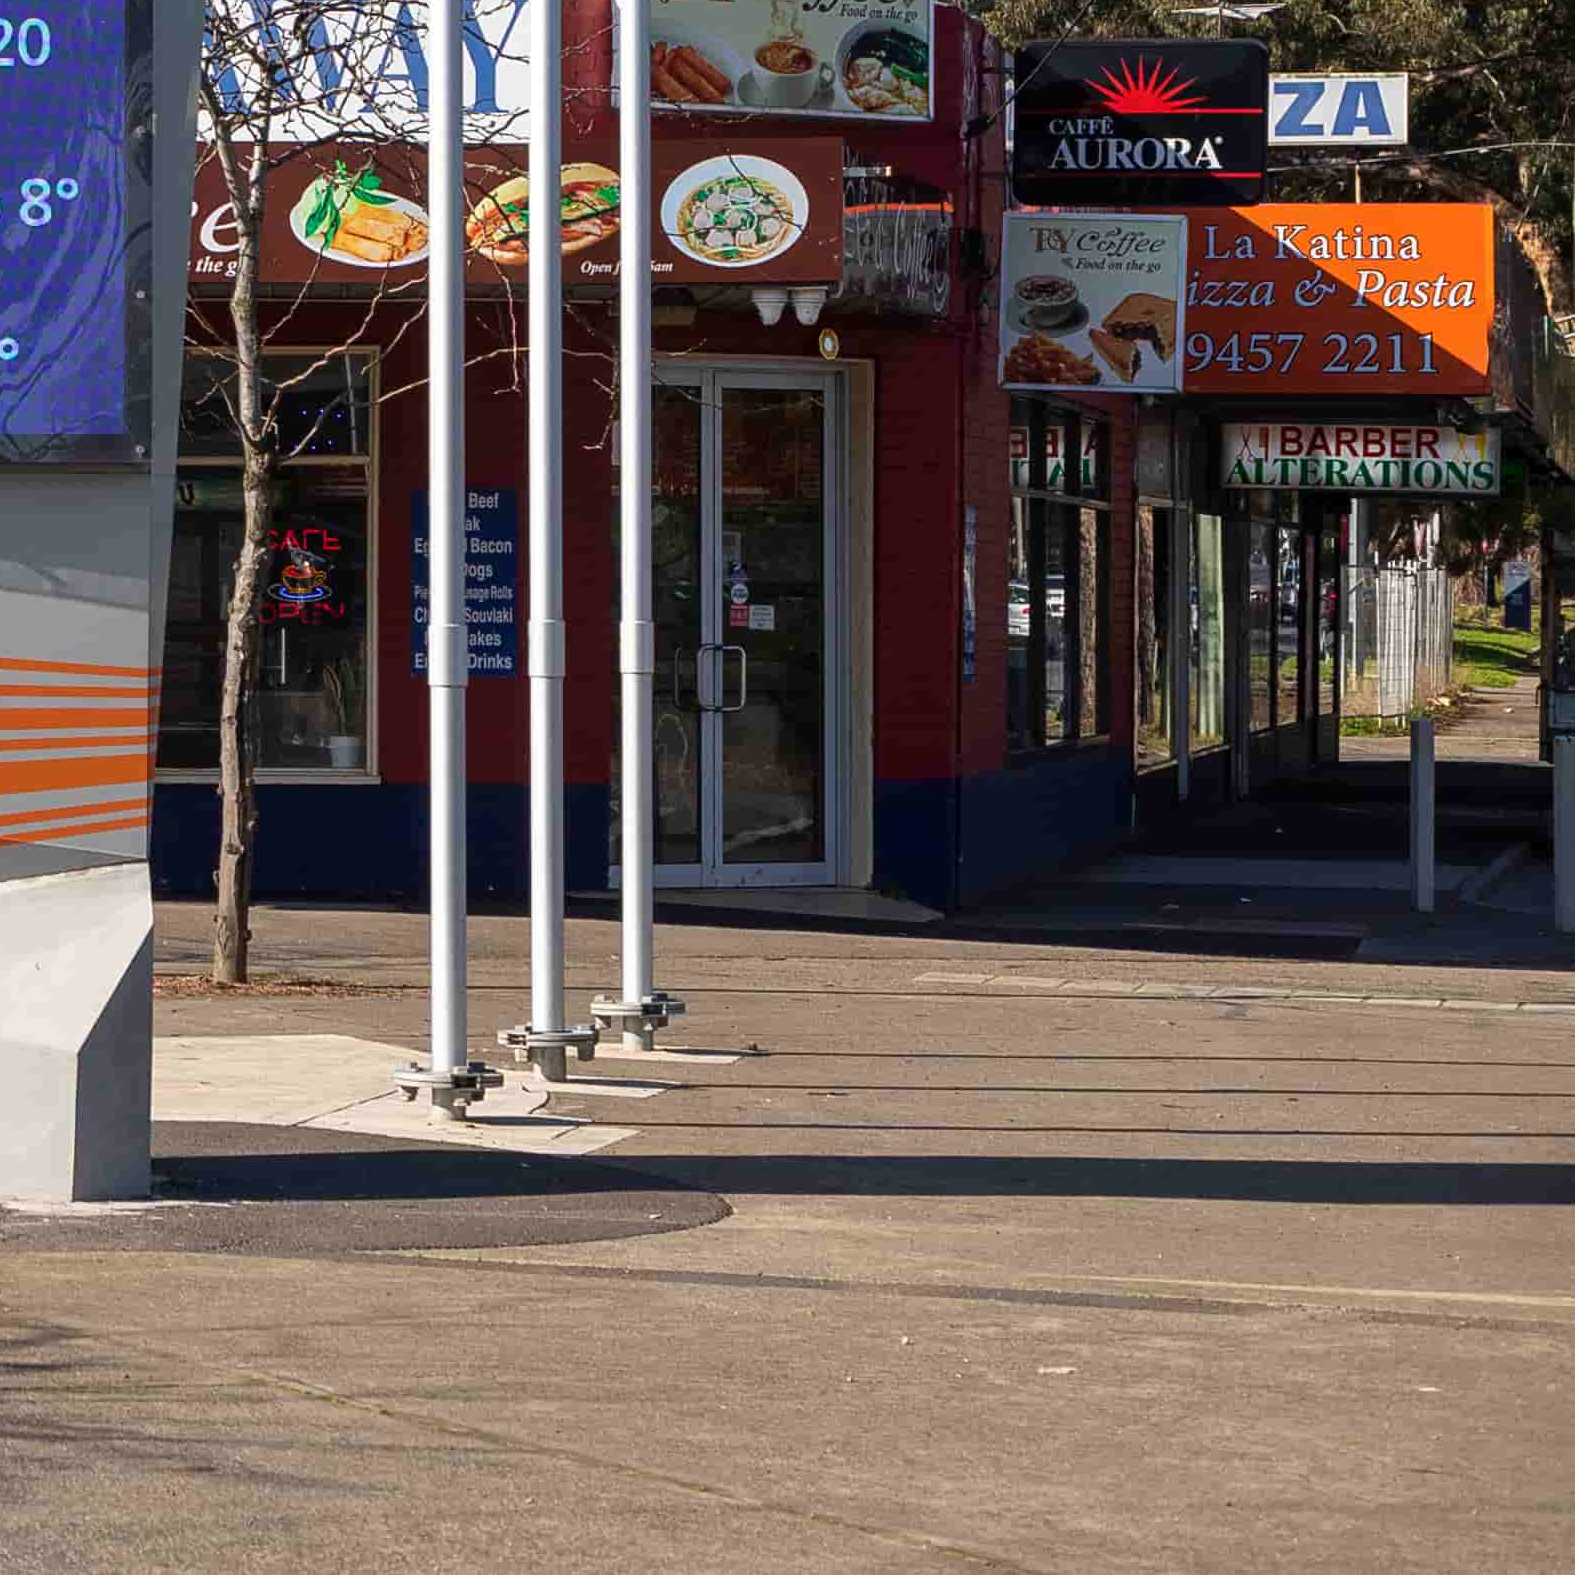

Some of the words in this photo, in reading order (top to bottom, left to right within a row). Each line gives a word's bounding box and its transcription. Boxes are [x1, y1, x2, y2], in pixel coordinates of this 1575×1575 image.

[840, 3, 866, 19] Food
[869, 8, 884, 19] on
[885, 6, 903, 20] the
[903, 10, 918, 24] go
[1076, 227, 1166, 257] Coffee
[1204, 225, 1255, 259] La
[1274, 225, 1421, 260] Katina
[195, 255, 224, 274] the
[580, 260, 612, 277] Open
[1075, 247, 1106, 270] Food
[1108, 254, 1123, 271] on
[1126, 248, 1143, 271] the
[1146, 255, 1162, 273] go
[1187, 269, 1276, 308] izza
[1294, 268, 1337, 308] &
[1351, 269, 1476, 309] Pasta
[1186, 331, 1304, 373] 9457
[1322, 331, 1438, 373] 2211
[1280, 426, 1441, 459] BARBER
[1227, 458, 1494, 490] ALTERATIONS
[468, 492, 500, 509] Beef
[470, 537, 513, 554] Bacon
[490, 585, 513, 600] Rolls
[463, 604, 514, 623] Souvlaki
[467, 652, 513, 670] Drinks
